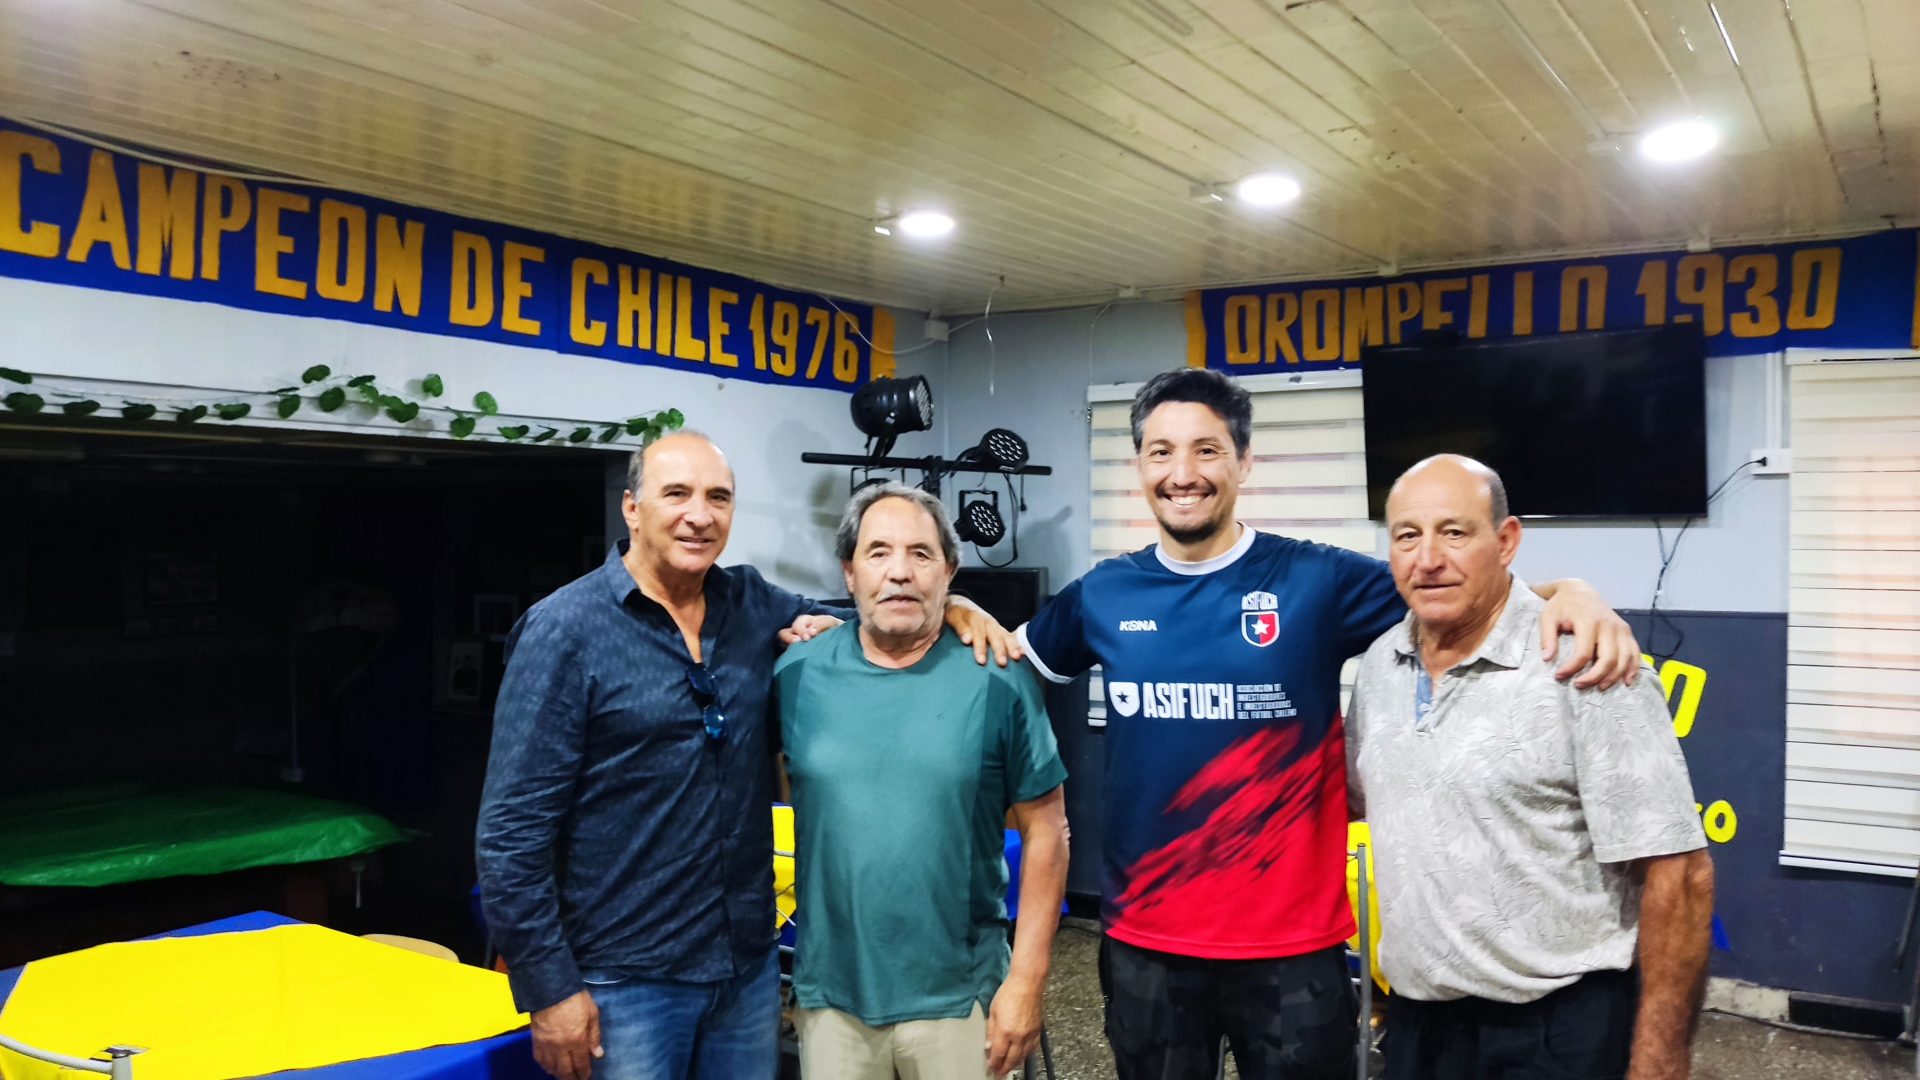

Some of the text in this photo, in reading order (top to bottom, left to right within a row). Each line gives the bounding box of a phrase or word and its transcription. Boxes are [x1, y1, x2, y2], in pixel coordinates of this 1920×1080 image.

[0, 131, 860, 383] CAMPEON DE CHILE 1976
[1635, 247, 1842, 338] 1930
[1143, 682, 1235, 719] ASIFUCH
